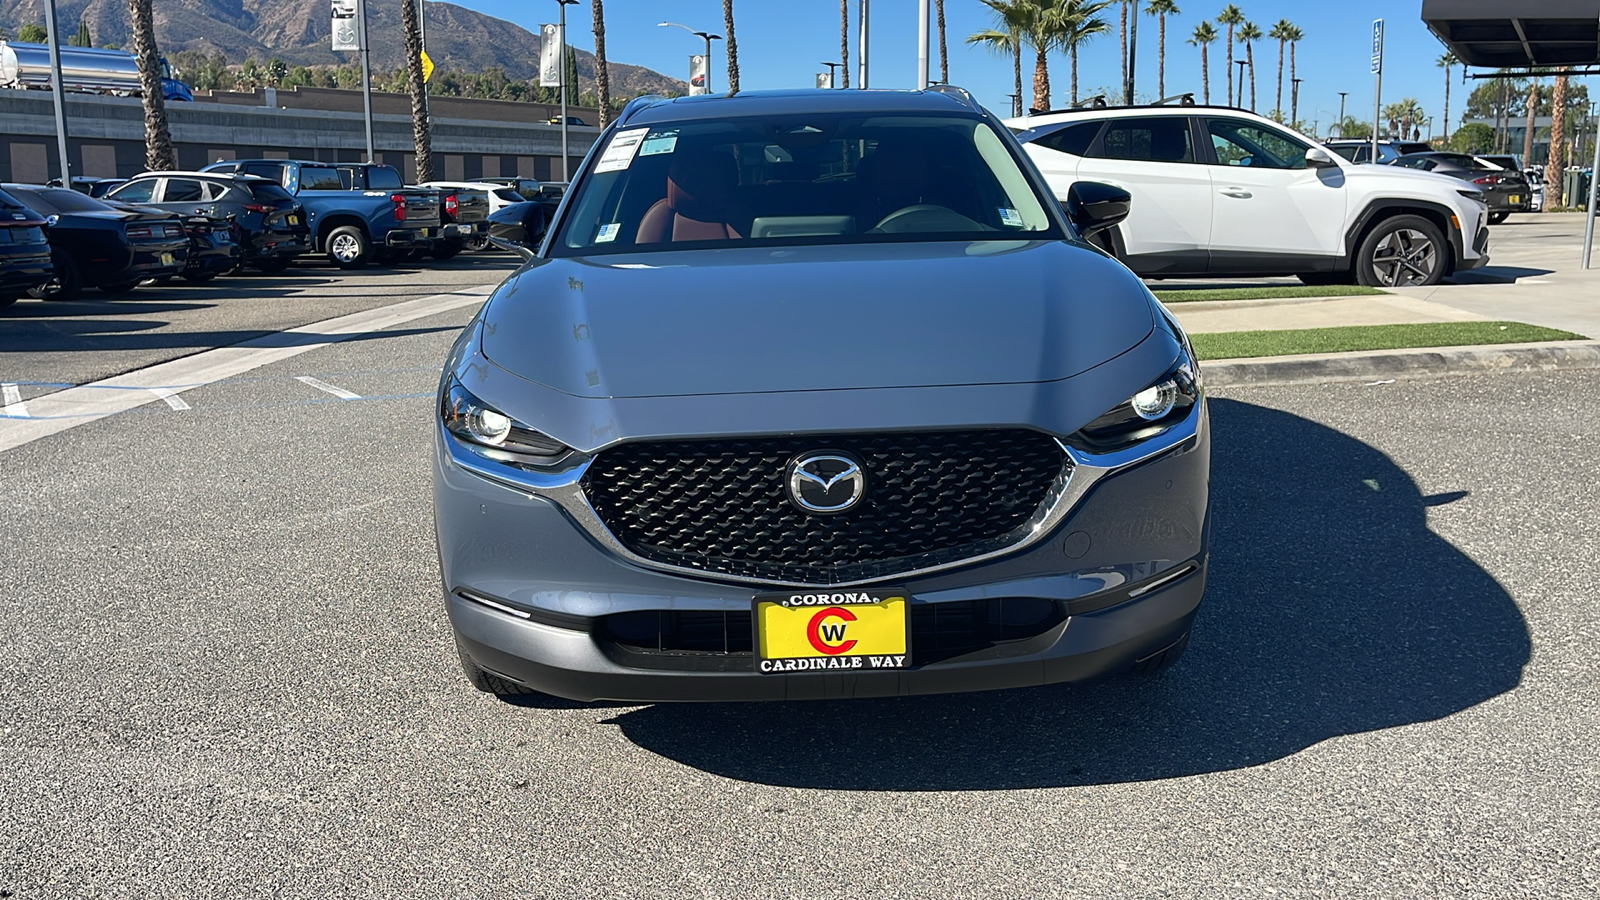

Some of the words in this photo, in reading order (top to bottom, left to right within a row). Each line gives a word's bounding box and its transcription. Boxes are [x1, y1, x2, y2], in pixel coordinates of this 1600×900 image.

[789, 592, 872, 606] CORONA
[760, 656, 863, 672] CARDINALE
[868, 655, 906, 668] WAY
